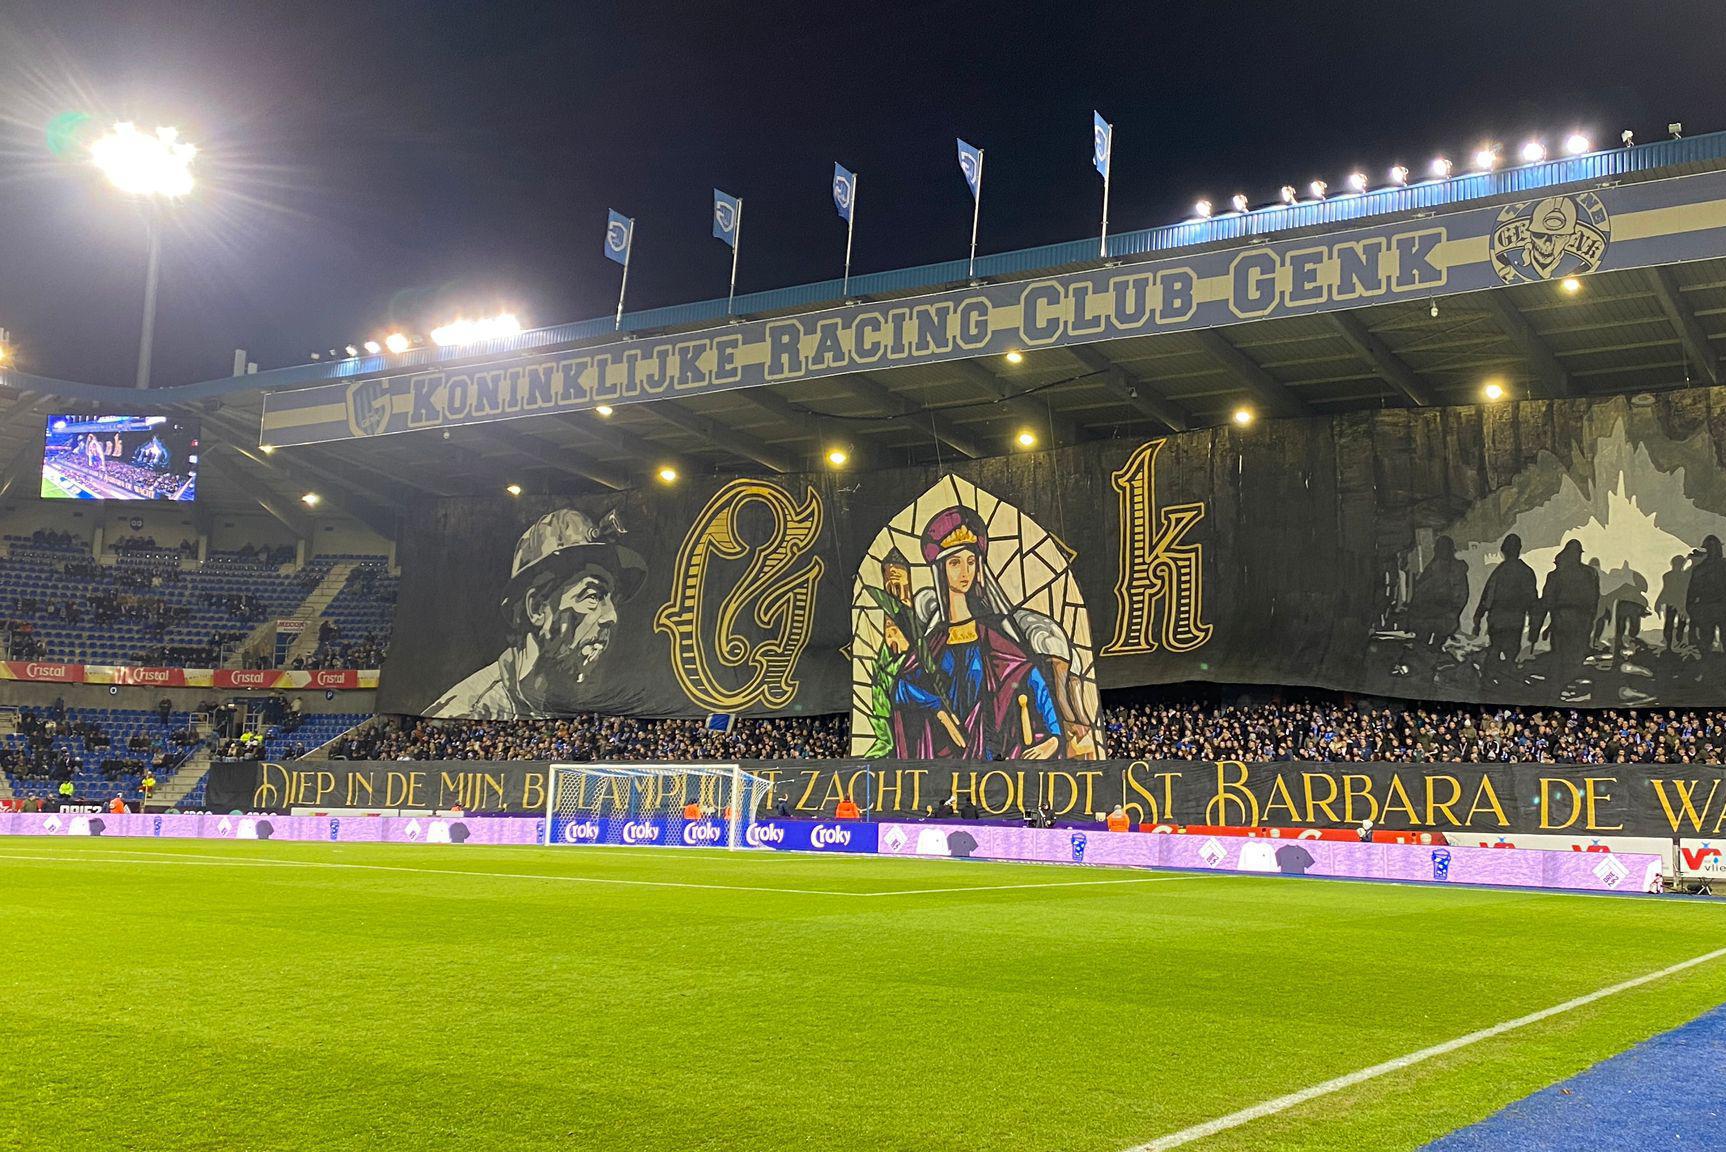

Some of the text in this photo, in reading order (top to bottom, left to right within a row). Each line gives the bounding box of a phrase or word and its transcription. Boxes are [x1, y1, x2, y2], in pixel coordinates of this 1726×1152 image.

[1019, 267, 1197, 345] CLUB
[1229, 227, 1447, 318] GENK
[26, 663, 65, 678] Cristal
[134, 667, 169, 682] Cristal
[231, 671, 264, 685] Cristal
[317, 671, 345, 685] Cristal
[345, 772, 373, 806] IN
[386, 772, 427, 807] DE
[1539, 777, 1624, 830] DE
[565, 821, 599, 842] Croky
[623, 821, 659, 843] Croky
[684, 821, 720, 844] Croky
[746, 822, 784, 846] Croky
[811, 824, 851, 848] Croky
